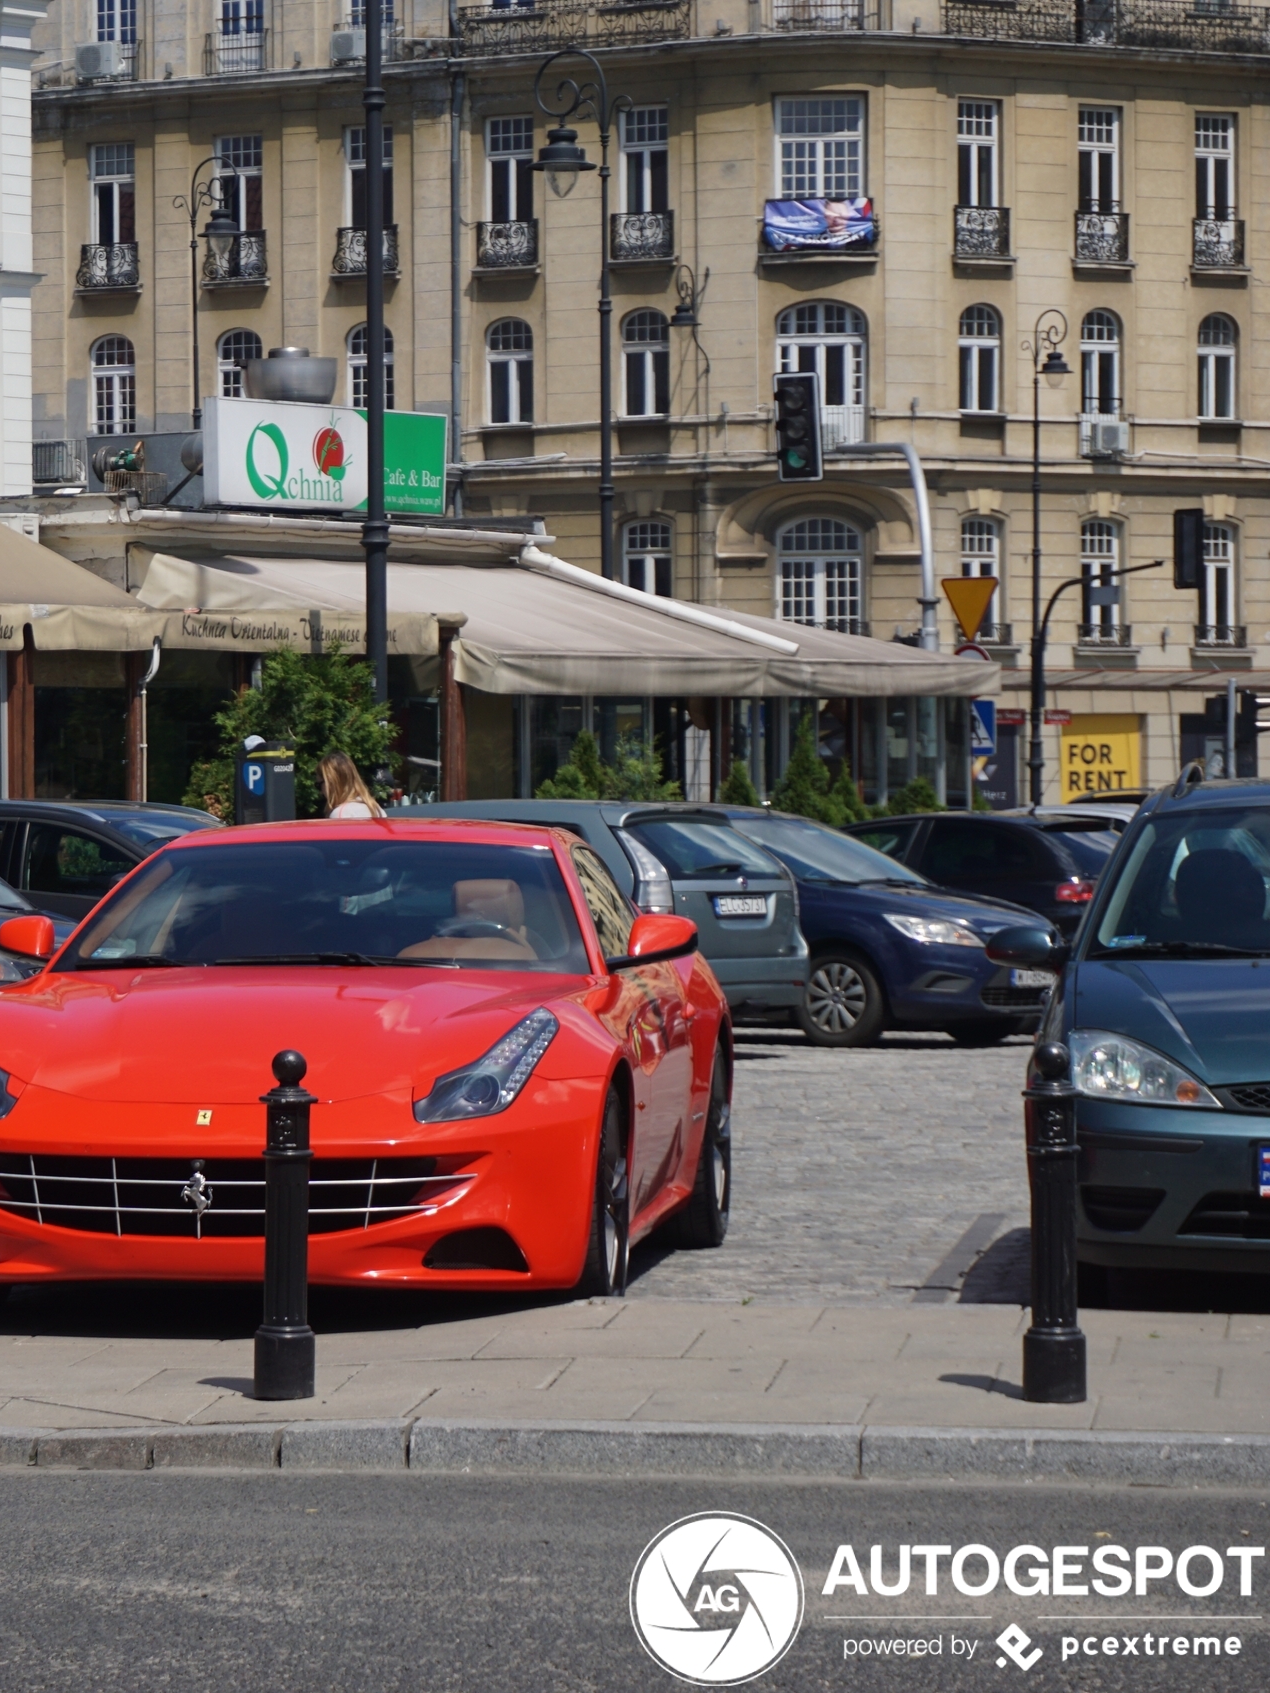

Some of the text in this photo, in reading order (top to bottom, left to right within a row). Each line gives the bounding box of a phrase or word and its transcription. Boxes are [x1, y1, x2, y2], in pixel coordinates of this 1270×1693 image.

[245, 419, 344, 503] Qchnia
[408, 469, 418, 486] &
[421, 470, 442, 488] Bar
[181, 615, 227, 639] Kuchnia
[299, 617, 360, 643] Vietnamese
[1068, 743, 1113, 765] FOR
[248, 765, 262, 790] P
[1068, 770, 1127, 791] RENT
